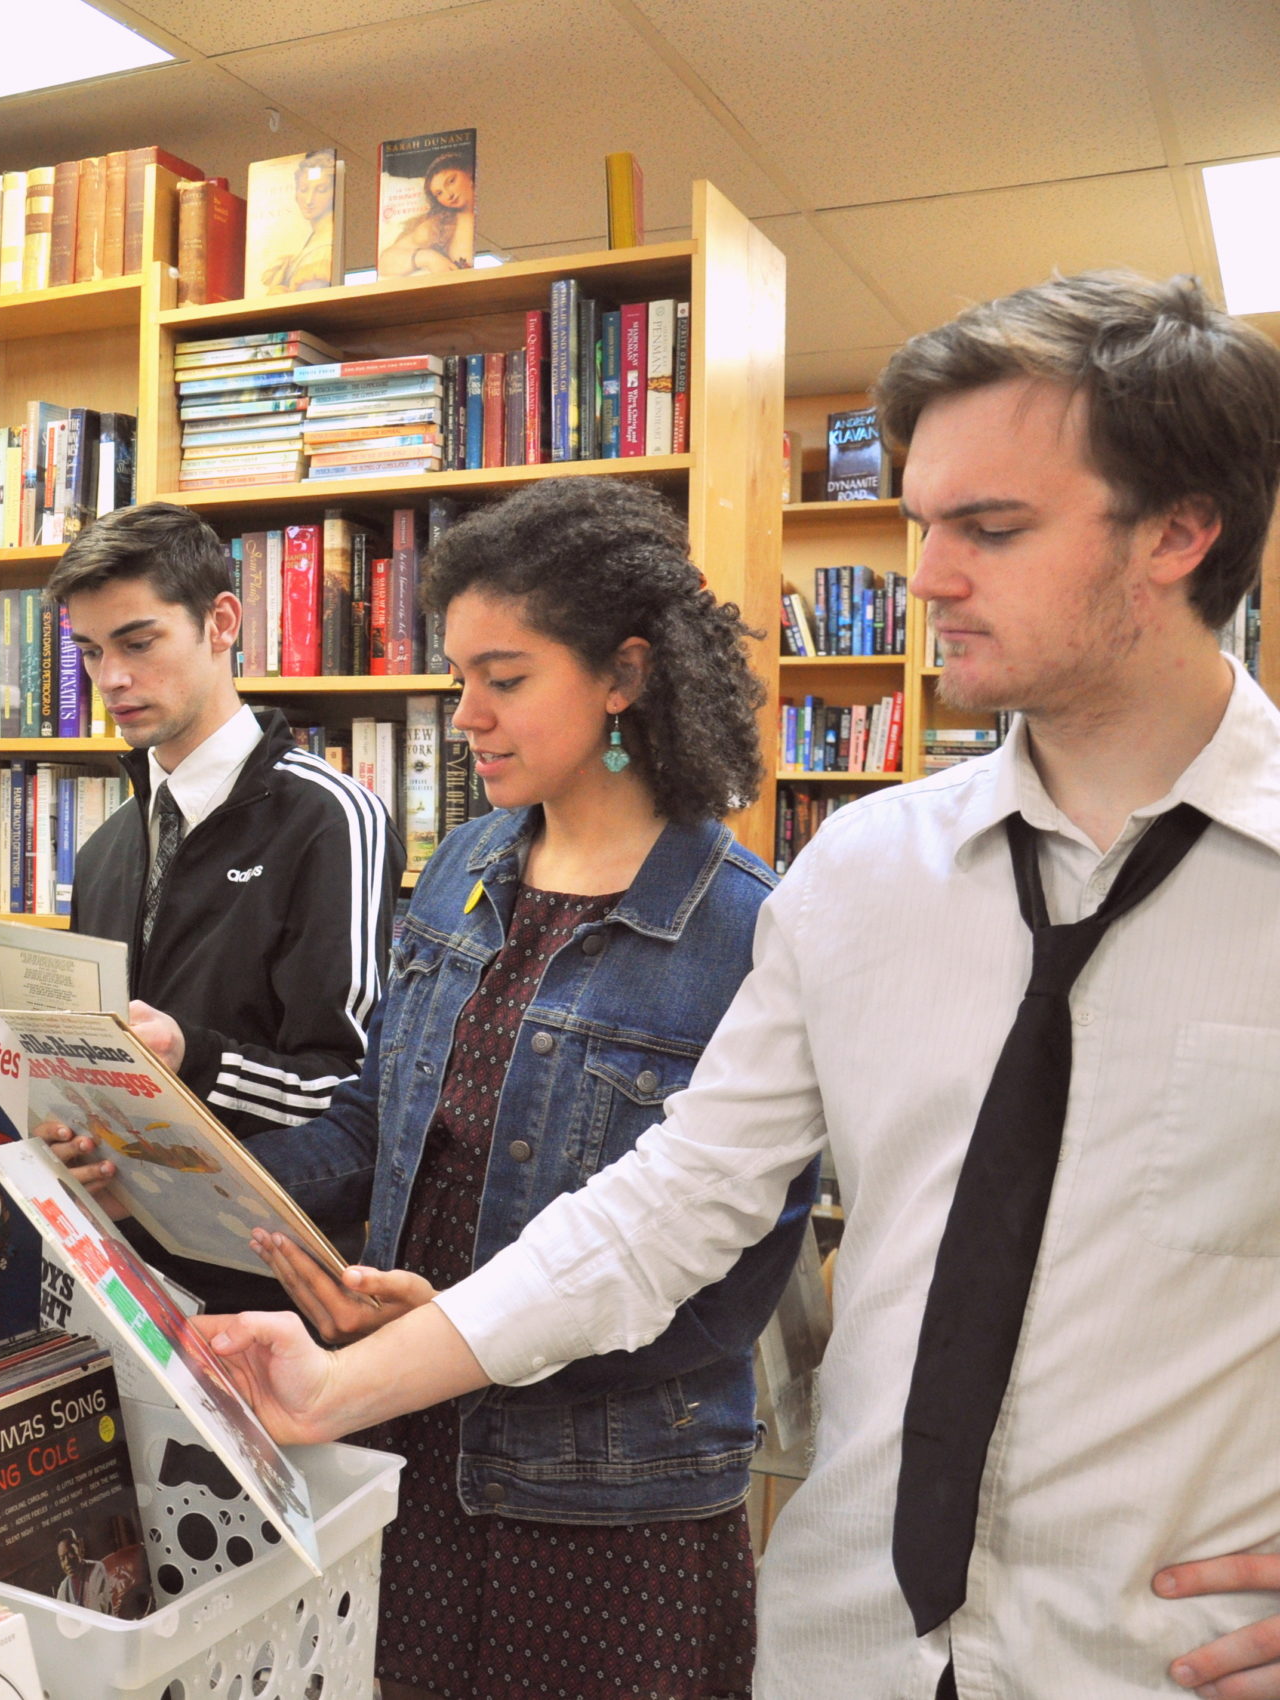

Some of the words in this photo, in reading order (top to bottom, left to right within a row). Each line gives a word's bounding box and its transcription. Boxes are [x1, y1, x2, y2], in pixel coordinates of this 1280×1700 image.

[385, 142, 420, 153] SARAH
[424, 133, 473, 148] DUNANT
[560, 308, 568, 327] LIFE
[560, 331, 568, 350] AND
[626, 327, 634, 362] PENMAN
[631, 321, 639, 348] SHARON
[651, 320, 664, 374] PENMAN
[560, 353, 568, 379] TIMES
[631, 351, 639, 366] KAY
[560, 381, 568, 392] OF
[678, 364, 688, 393] BLOOD
[631, 388, 640, 407] When
[631, 432, 640, 443] and
[829, 426, 880, 446] KLAVAN
[827, 475, 880, 493] DYNAMITE
[838, 489, 868, 502] ROAD
[42, 611, 52, 638] SEVEN
[42, 638, 52, 657] DAYS
[60, 635, 77, 668] DAVID
[42, 658, 52, 668] TO
[41, 669, 52, 716] PETROGRAD
[59, 668, 77, 720] IGNATIUS
[406, 727, 435, 742] NEW
[406, 744, 433, 759] YORK
[446, 745, 468, 788] VEIL
[12, 786, 23, 808] HARD
[446, 791, 466, 805] OF
[12, 808, 23, 830] ROAD
[12, 830, 22, 841] TO
[11, 842, 22, 888] GETTYSBURG
[45, 1035, 136, 1066] Airplane
[57, 1057, 163, 1099] Scruggs
[51, 1389, 108, 1431] SONG
[27, 1437, 80, 1477] COLE
